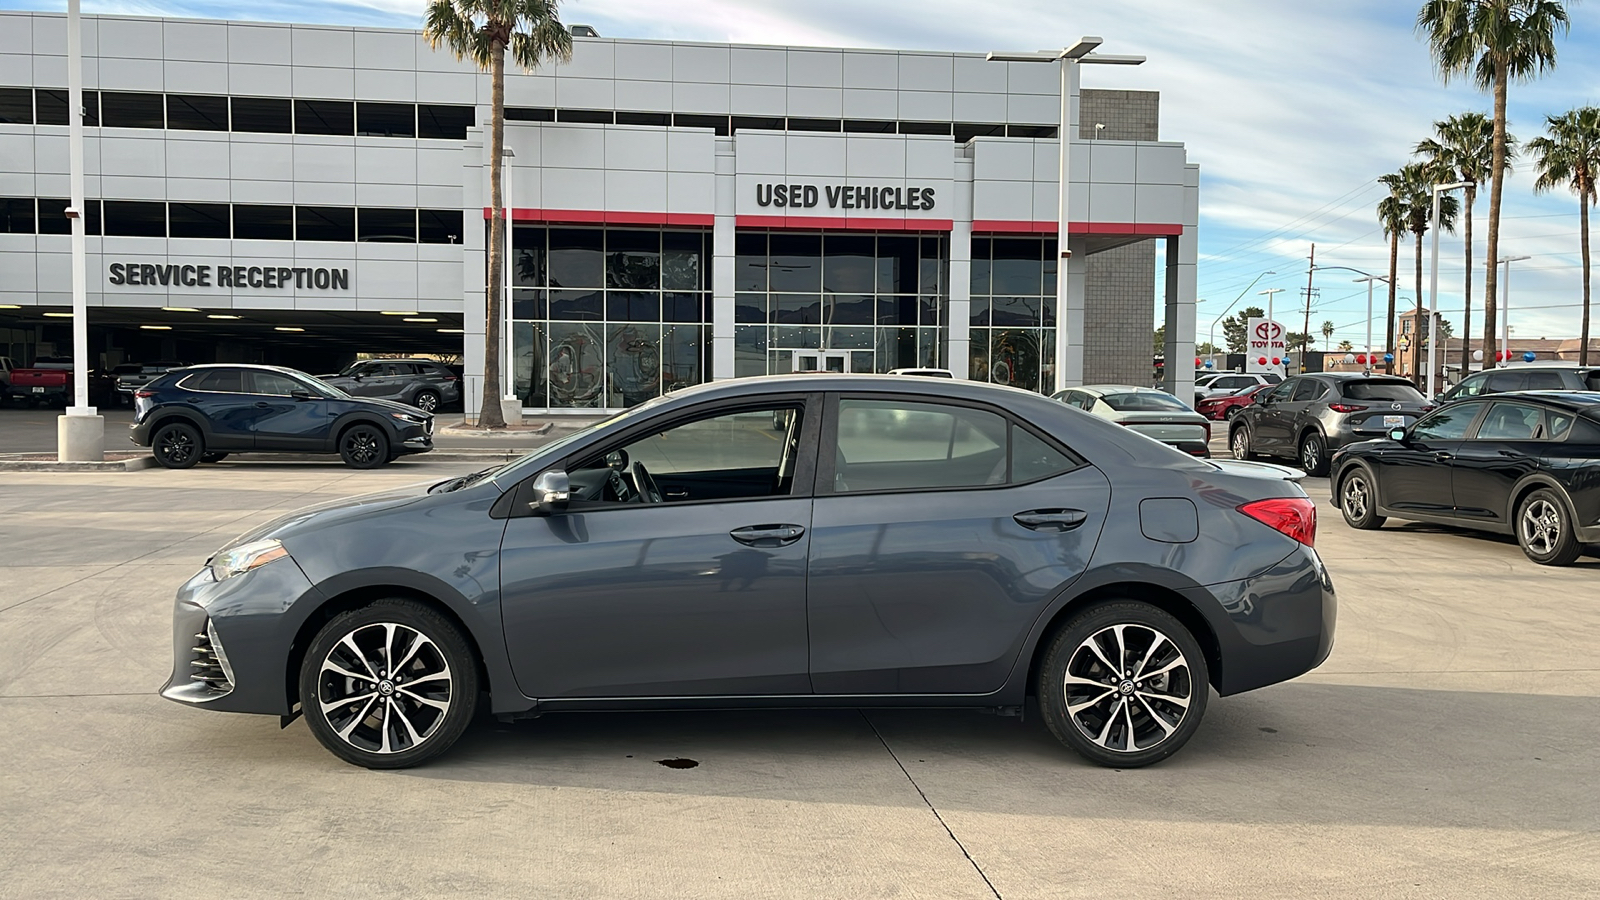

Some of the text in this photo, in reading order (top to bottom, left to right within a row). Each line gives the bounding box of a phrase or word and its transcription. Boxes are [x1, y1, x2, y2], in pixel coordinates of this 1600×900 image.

[756, 183, 936, 211] USED VEHICLES
[109, 263, 350, 290] SERVICE RECEPTION
